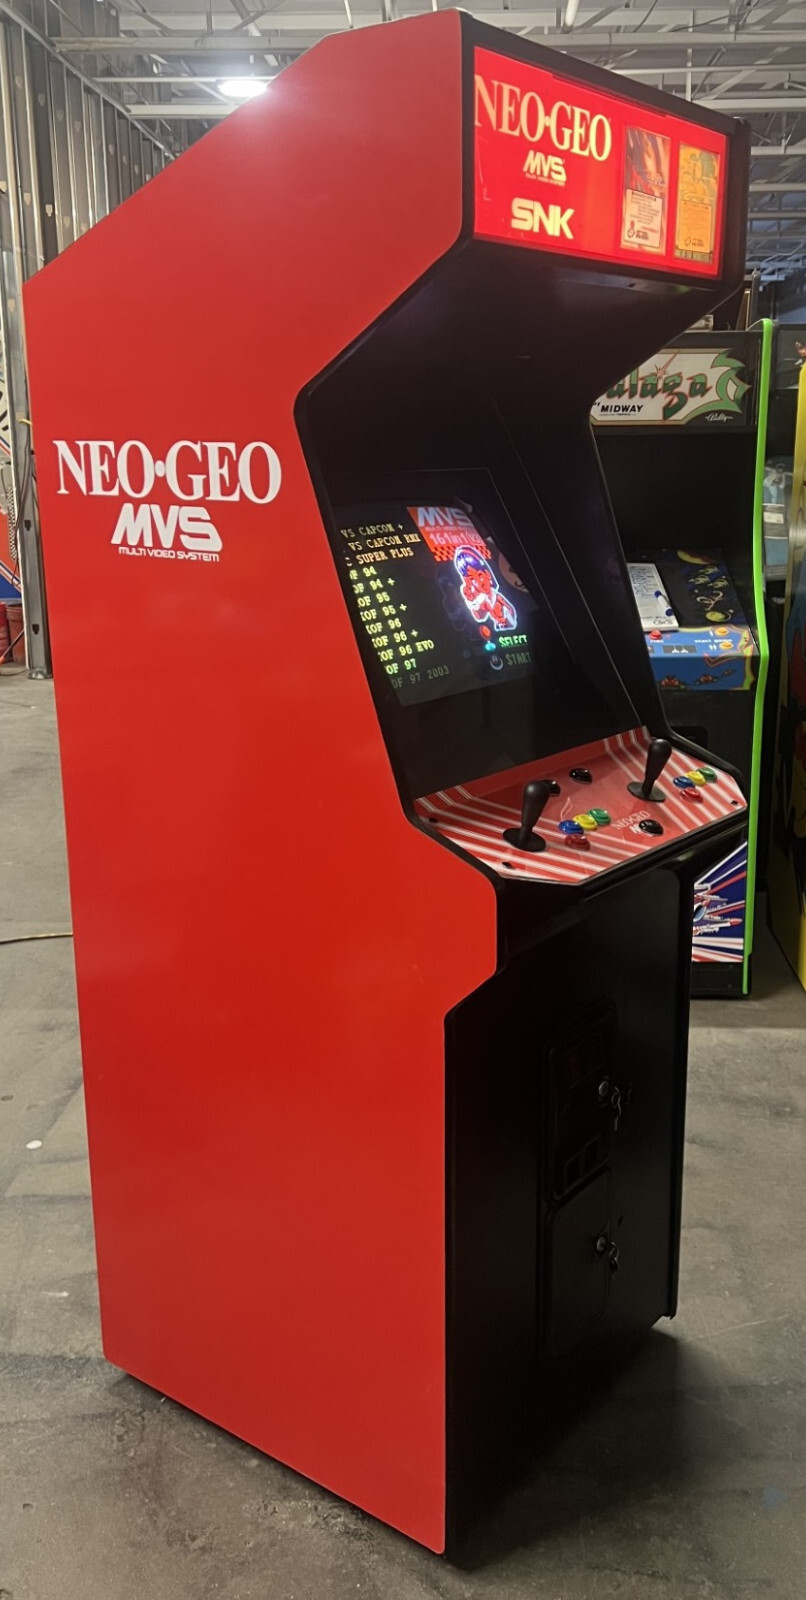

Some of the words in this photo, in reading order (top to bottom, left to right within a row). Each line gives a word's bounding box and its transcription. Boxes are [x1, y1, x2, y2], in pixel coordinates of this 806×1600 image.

[523, 150, 567, 182] MVS
[511, 197, 575, 239] SNK
[601, 405, 643, 413] MIDWAY
[418, 507, 474, 527] MVS
[111, 503, 223, 552] MVS
[347, 541, 363, 551] VS
[118, 546, 146, 556] MULTI
[147, 548, 175, 559] VIDEO
[177, 551, 219, 562] SYSTEM
[356, 551, 388, 564] SUPER
[389, 547, 414, 558] PLUS
[362, 565, 377, 577] 94
[369, 578, 384, 590] 94
[375, 591, 391, 603] 95
[382, 604, 397, 616] 95
[393, 630, 408, 643] 96
[399, 644, 413, 657] 96
[415, 639, 435, 653] EVO
[404, 658, 417, 670] 97
[505, 651, 532, 666] START
[410, 672, 421, 684] 97
[427, 665, 450, 680] 2003
